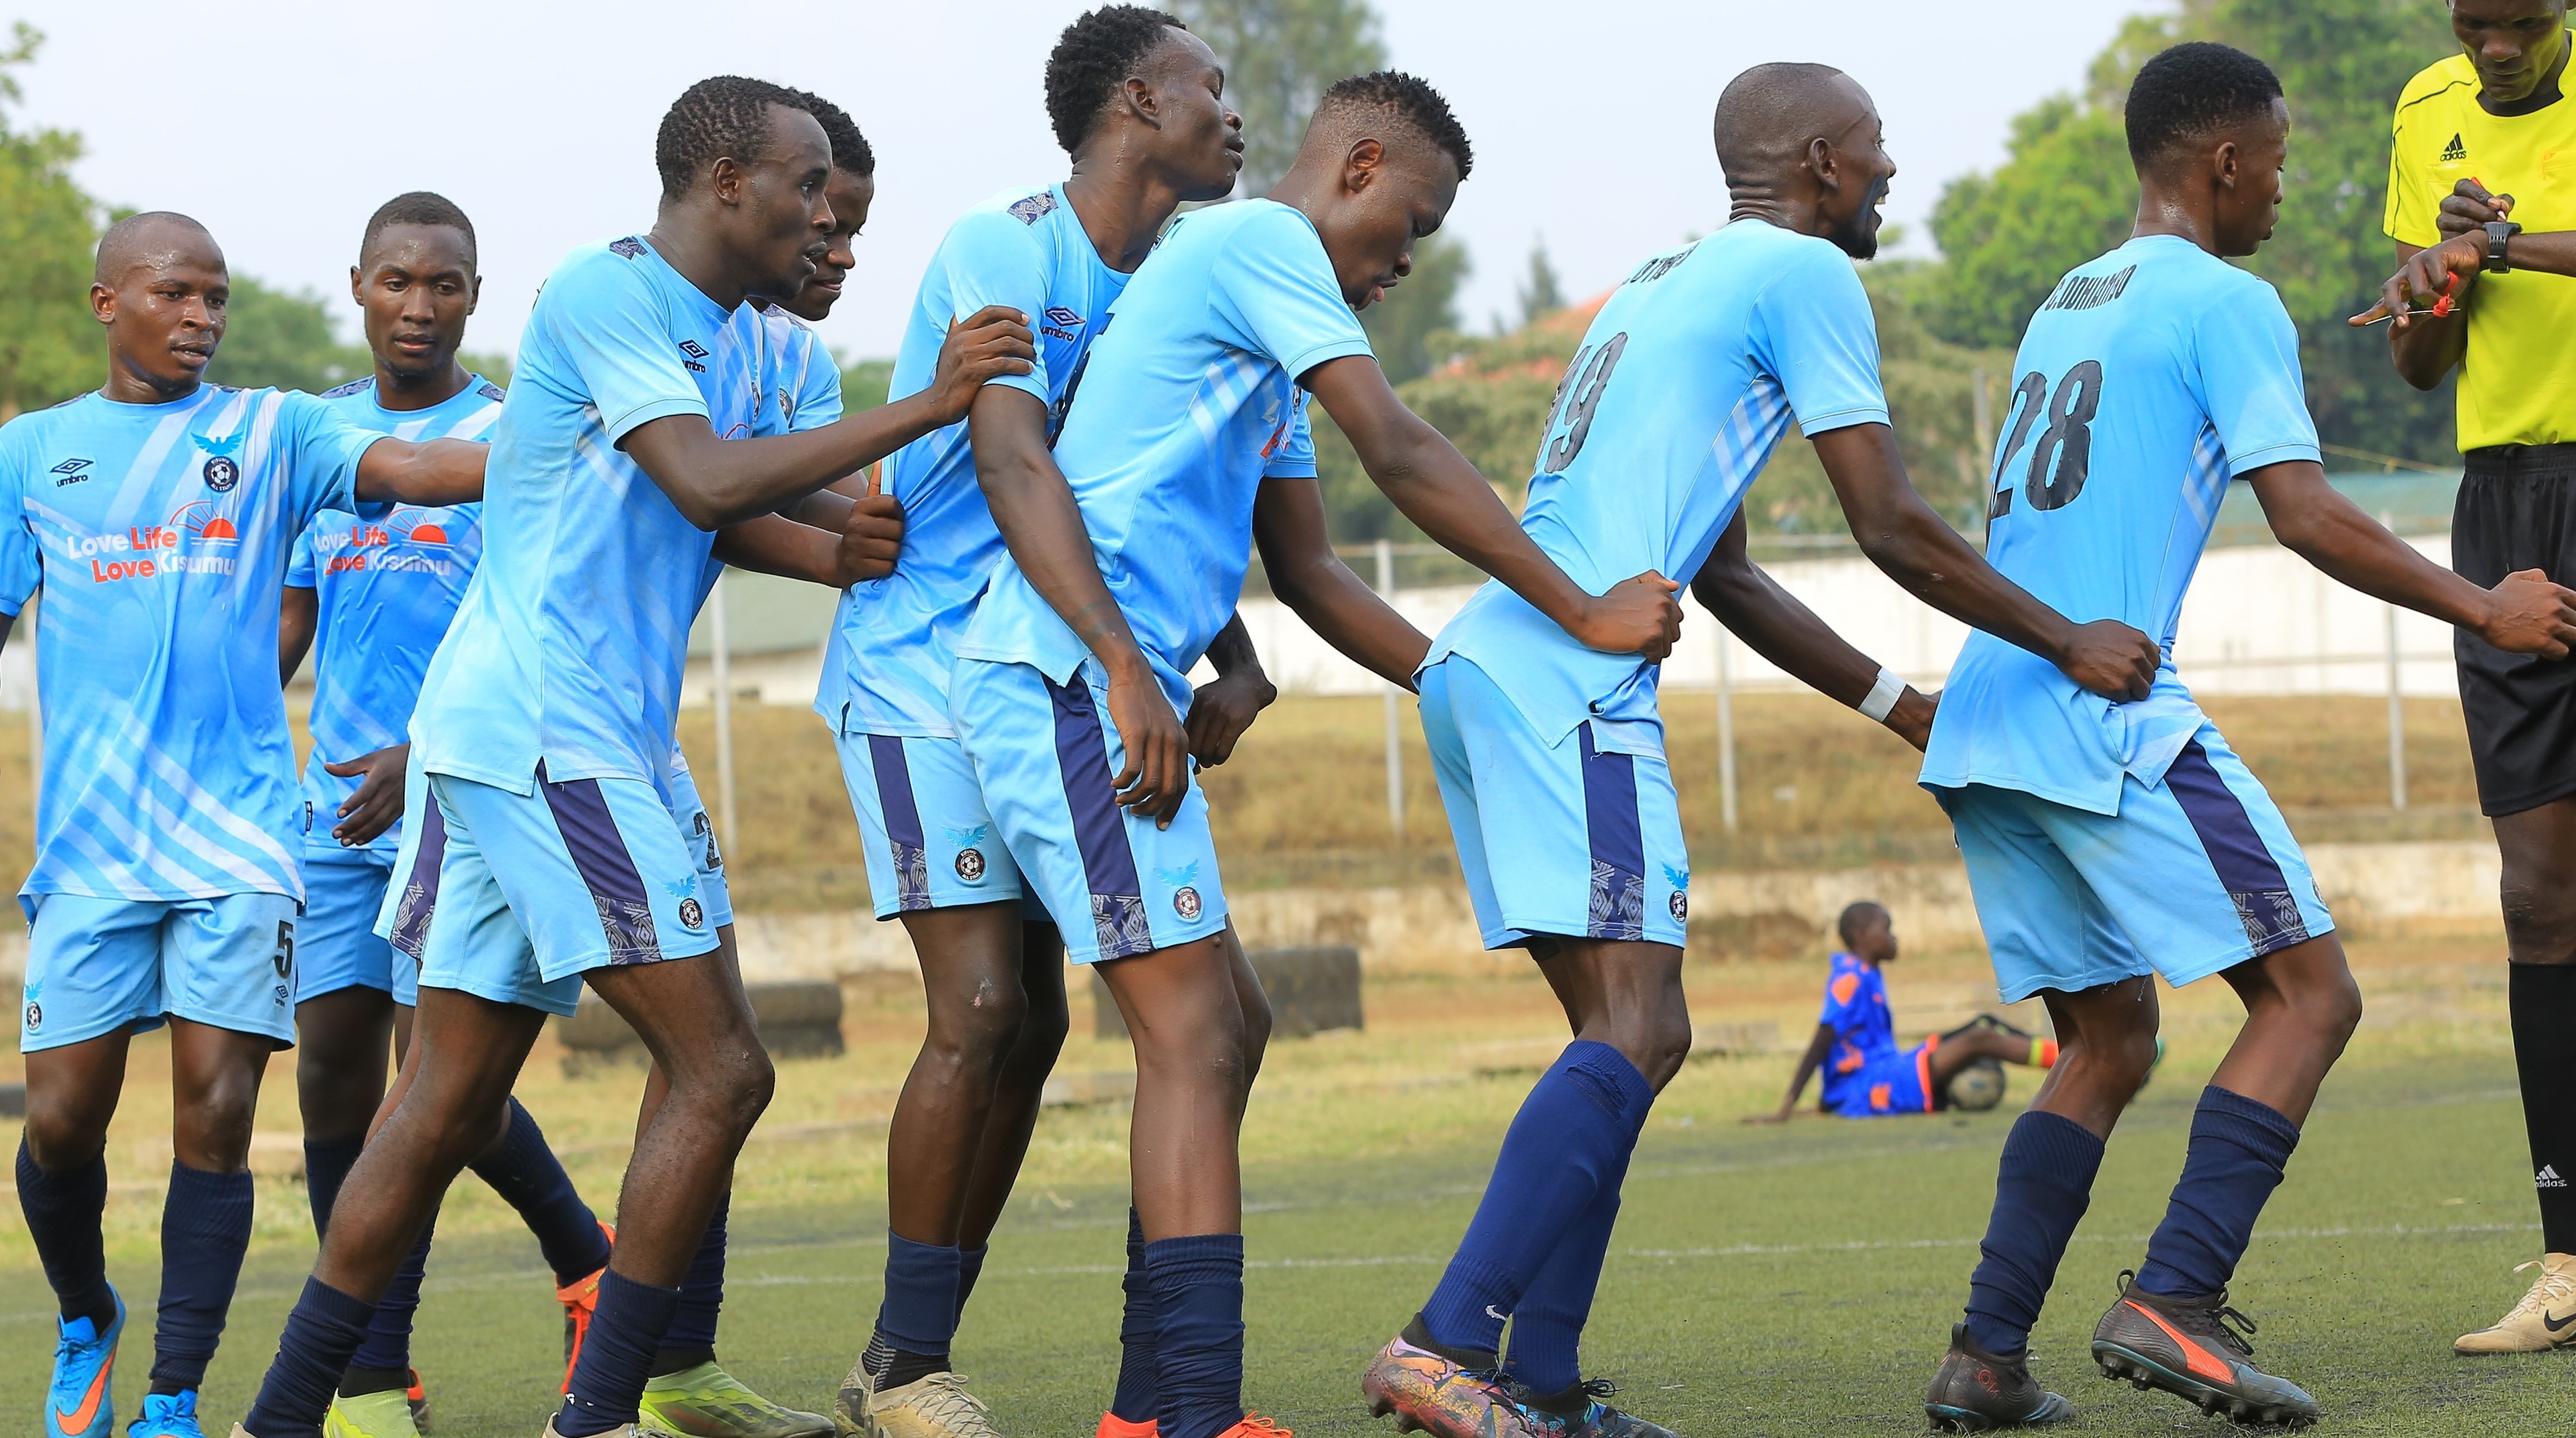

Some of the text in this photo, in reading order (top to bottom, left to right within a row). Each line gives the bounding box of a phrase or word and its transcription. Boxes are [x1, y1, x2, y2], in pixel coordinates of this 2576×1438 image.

[2440, 150, 2466, 162] adidas
[2044, 264, 2137, 311] C.ODHIAMBO
[1988, 360, 2103, 520] 28
[57, 474, 88, 488] umbro
[67, 526, 178, 560] Love Life
[314, 525, 389, 552] Love Life
[91, 548, 237, 584] Love Kisumu
[325, 549, 451, 576] Love Kisumu
[274, 919, 294, 979] 5
